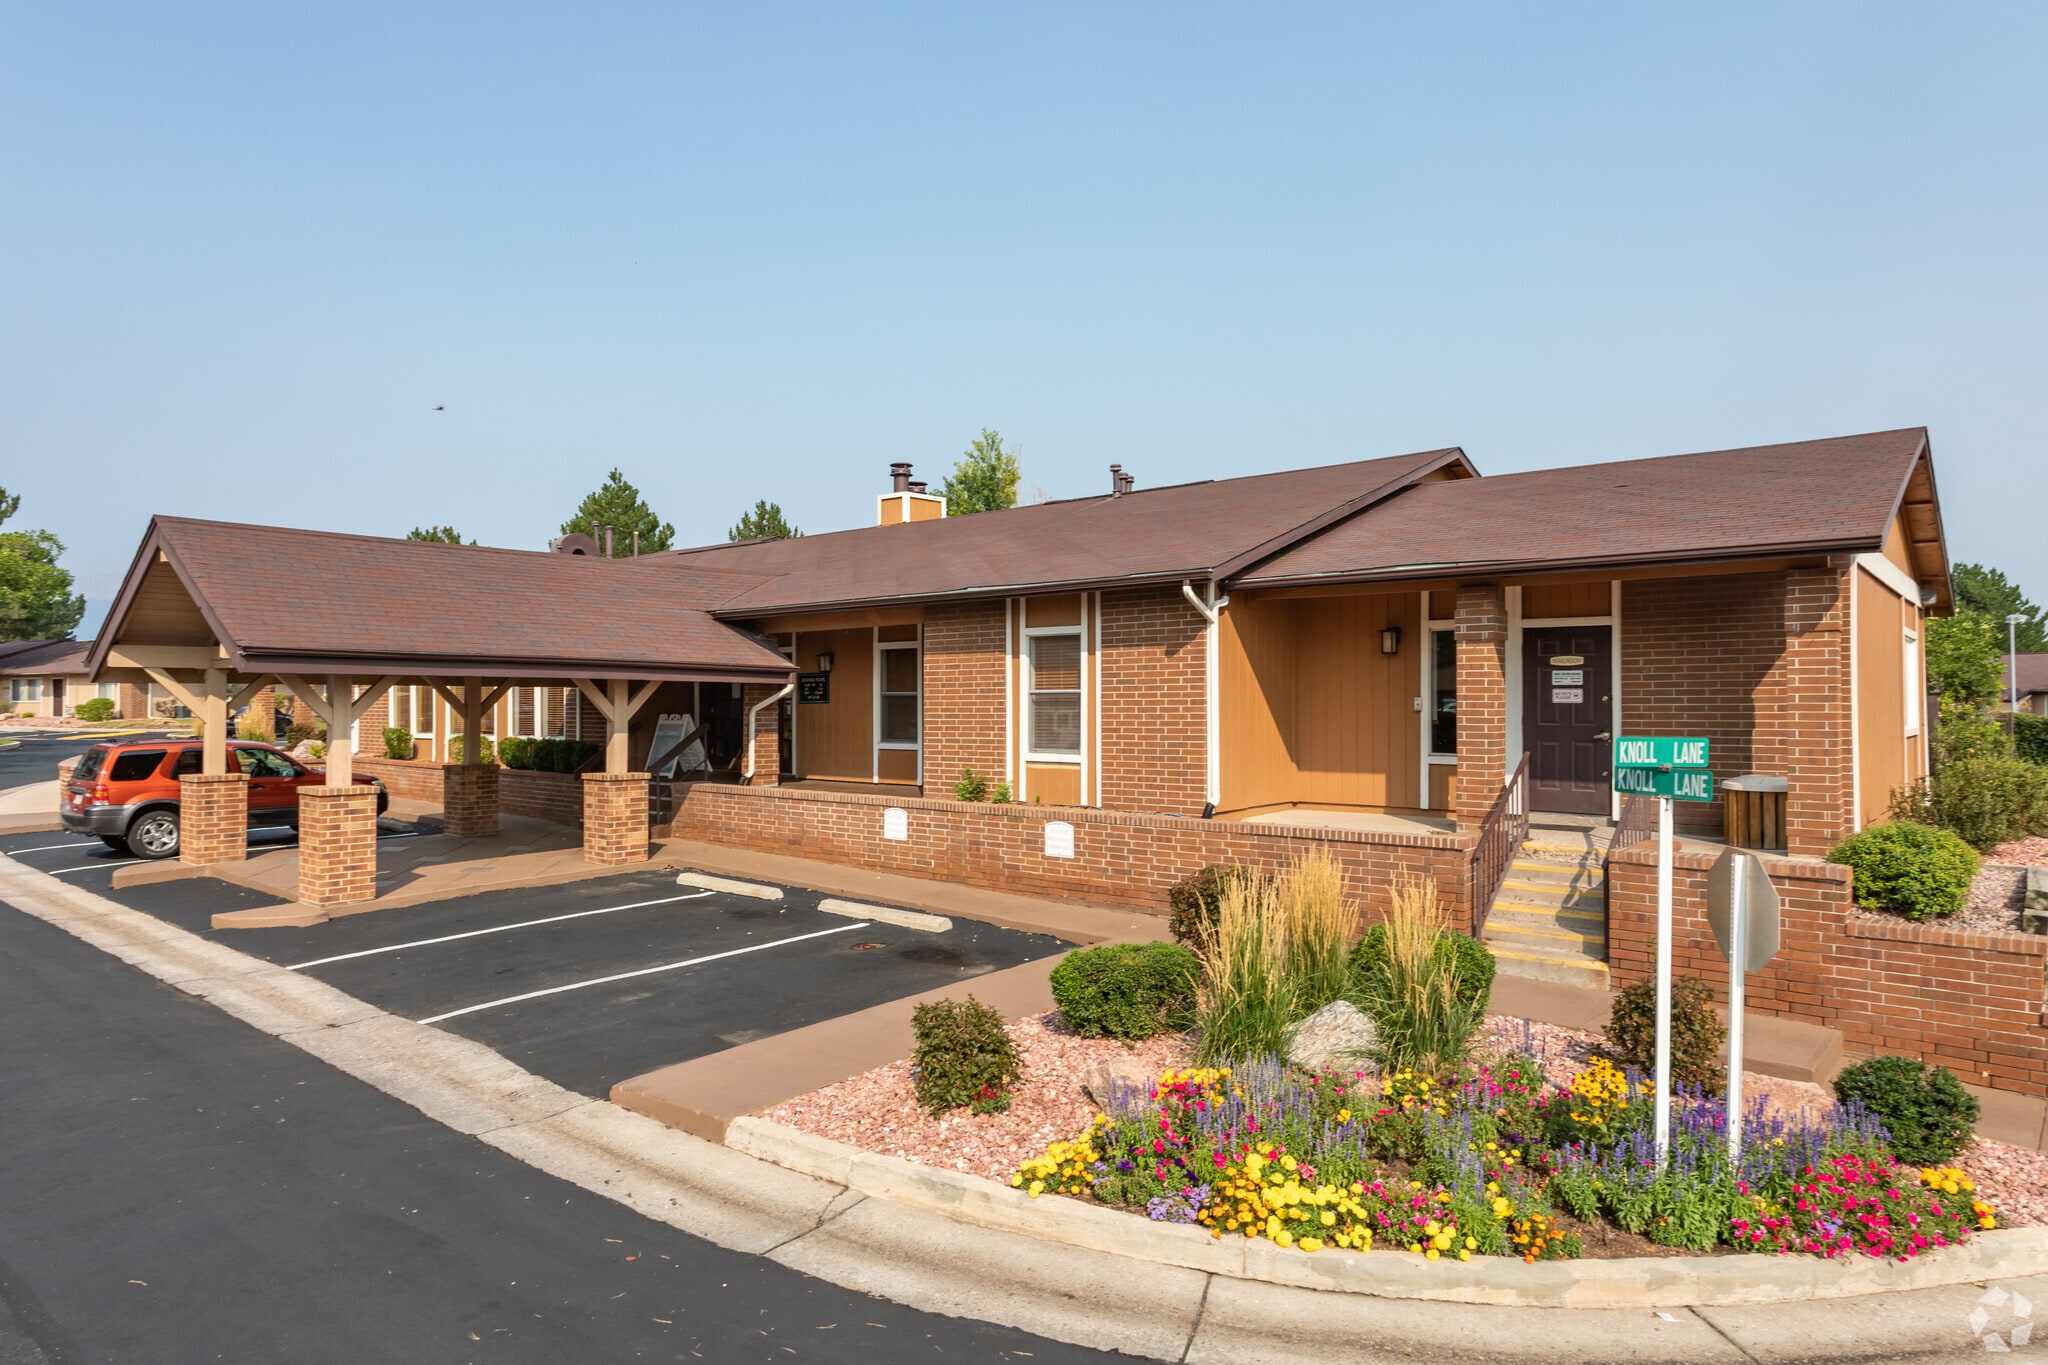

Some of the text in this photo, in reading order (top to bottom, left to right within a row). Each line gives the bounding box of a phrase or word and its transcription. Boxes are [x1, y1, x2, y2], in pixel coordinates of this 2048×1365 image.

[1619, 741, 1705, 764] KNOLL LANE
[1618, 768, 1709, 798] KNOLL LANE
